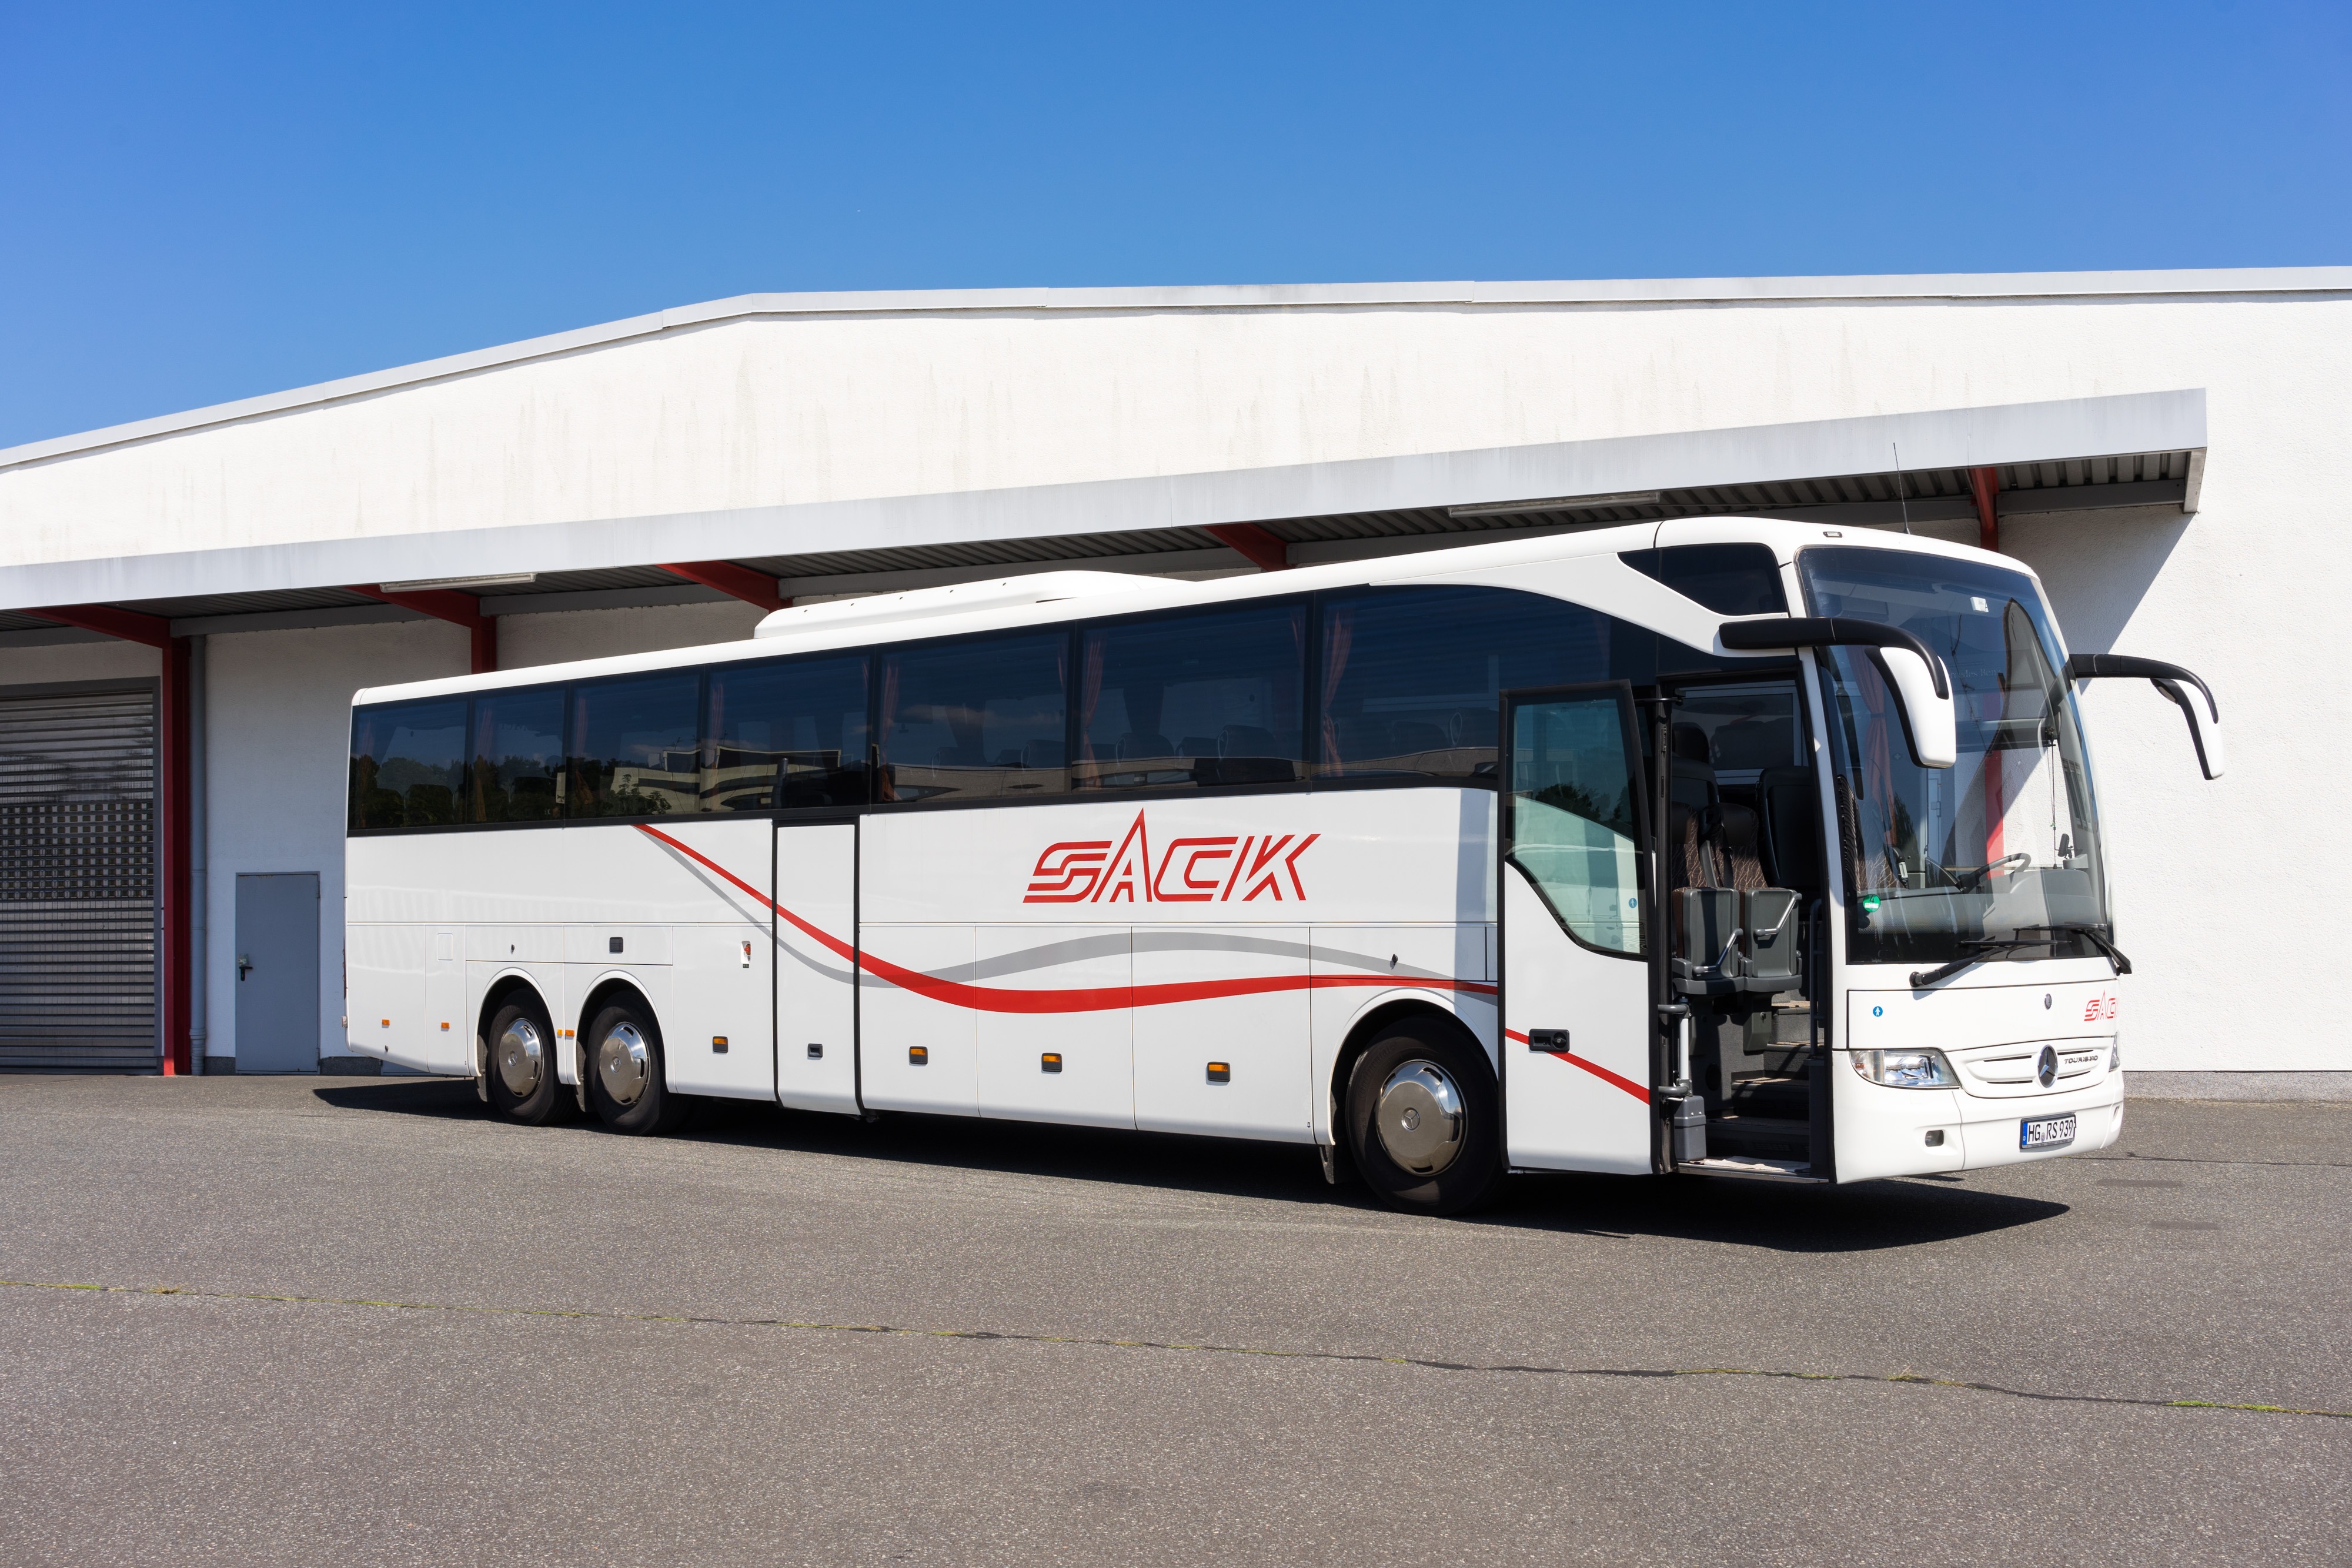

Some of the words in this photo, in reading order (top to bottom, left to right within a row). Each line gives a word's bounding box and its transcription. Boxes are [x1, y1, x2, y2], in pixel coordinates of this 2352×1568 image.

[1869, 894, 1875, 904] 4
[2028, 1124, 2041, 1142] HG
[2046, 1121, 2058, 1140] RS
[2059, 1119, 2074, 1138] 939
